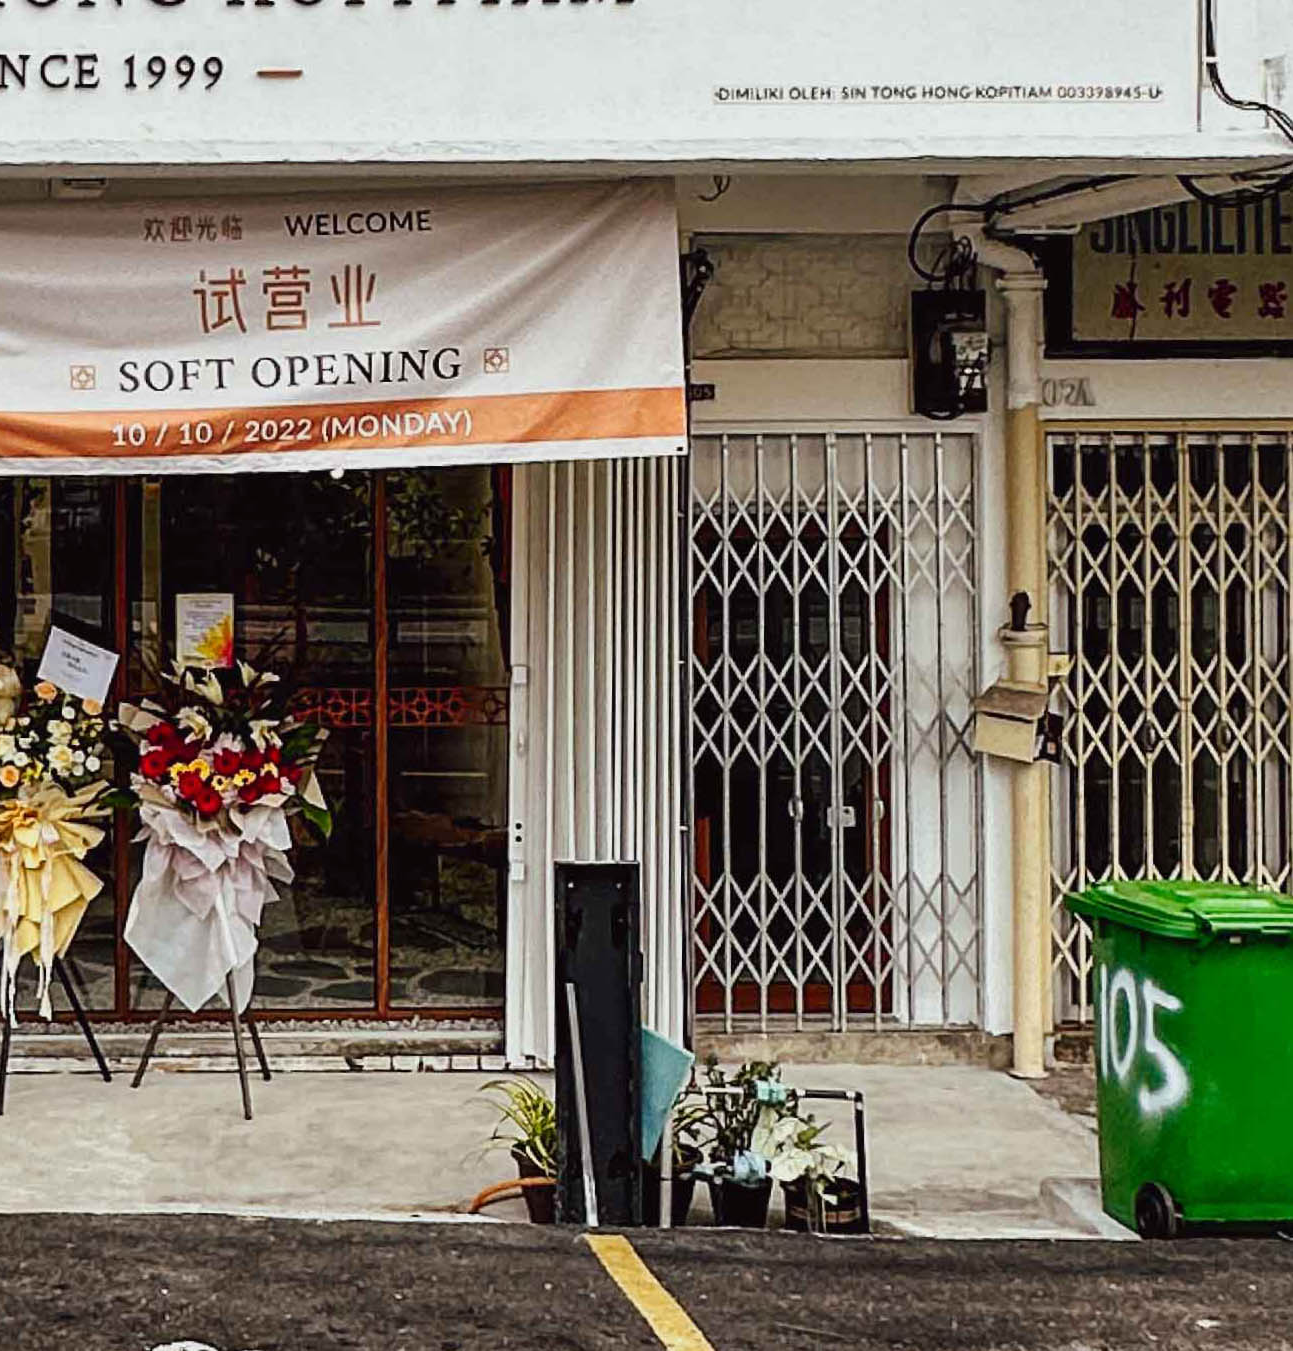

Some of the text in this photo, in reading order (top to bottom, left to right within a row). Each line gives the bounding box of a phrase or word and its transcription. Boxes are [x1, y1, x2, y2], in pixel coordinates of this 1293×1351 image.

[123, 54, 224, 90] 1999
[717, 86, 784, 101] DIMILIKI
[841, 86, 866, 100] SIN
[871, 86, 917, 99] TONG
[922, 85, 971, 99] HONG
[975, 85, 1052, 99] KOPITIAM
[143, 215, 243, 242] 欢迎光临
[284, 209, 432, 237] WELCOME
[192, 264, 382, 334] 试营业
[119, 347, 462, 394] SOFT OPENING
[111, 408, 474, 448] 10 / 10 / 2022 (MONDAY)
[1100, 963, 1192, 1116] 105
